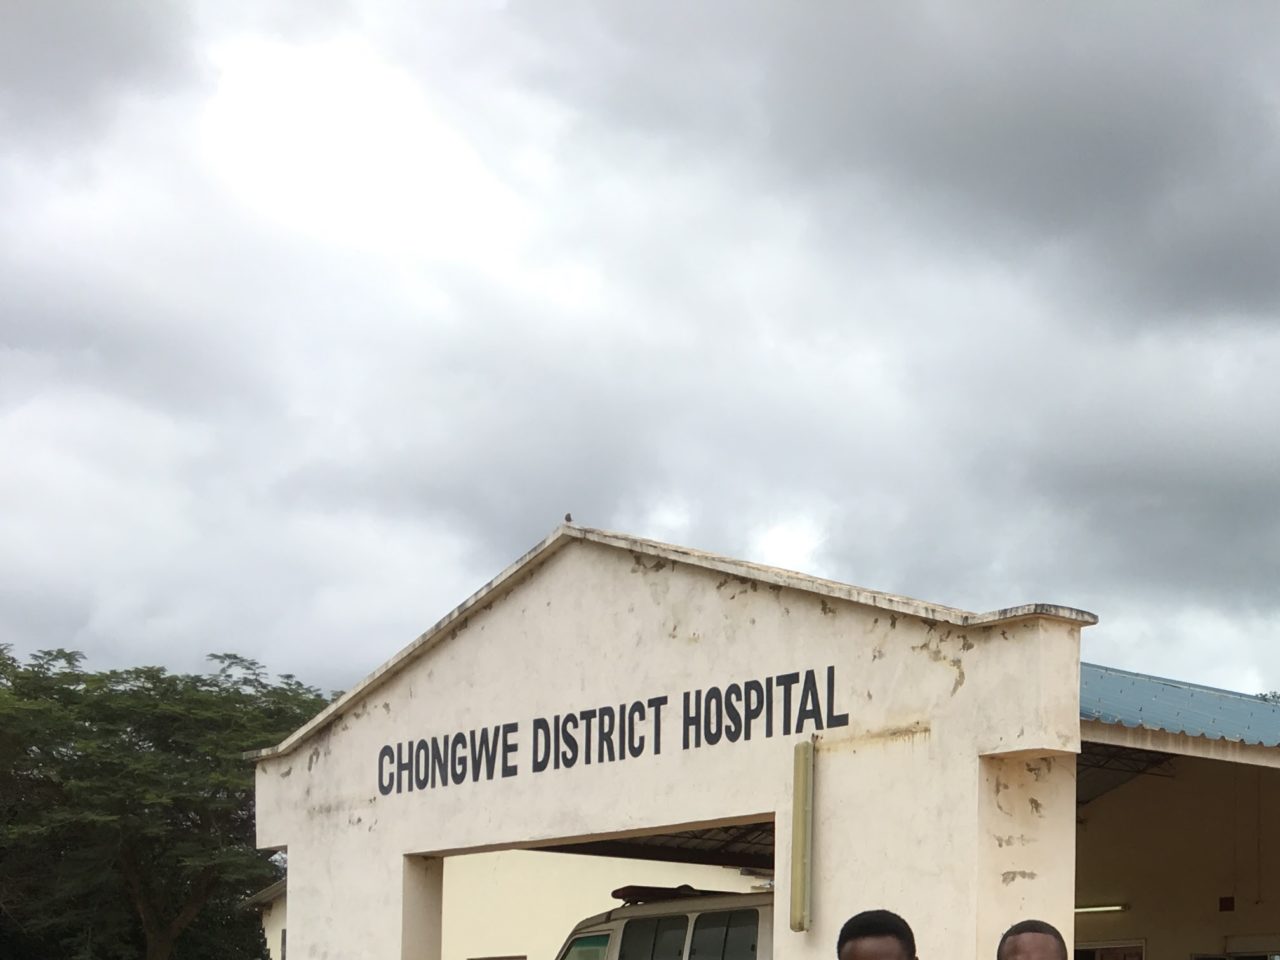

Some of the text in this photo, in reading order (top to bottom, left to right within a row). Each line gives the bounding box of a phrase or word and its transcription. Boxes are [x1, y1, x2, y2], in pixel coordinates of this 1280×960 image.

[378, 665, 849, 796] CHONGWE DISTRICT HOSPITAL
